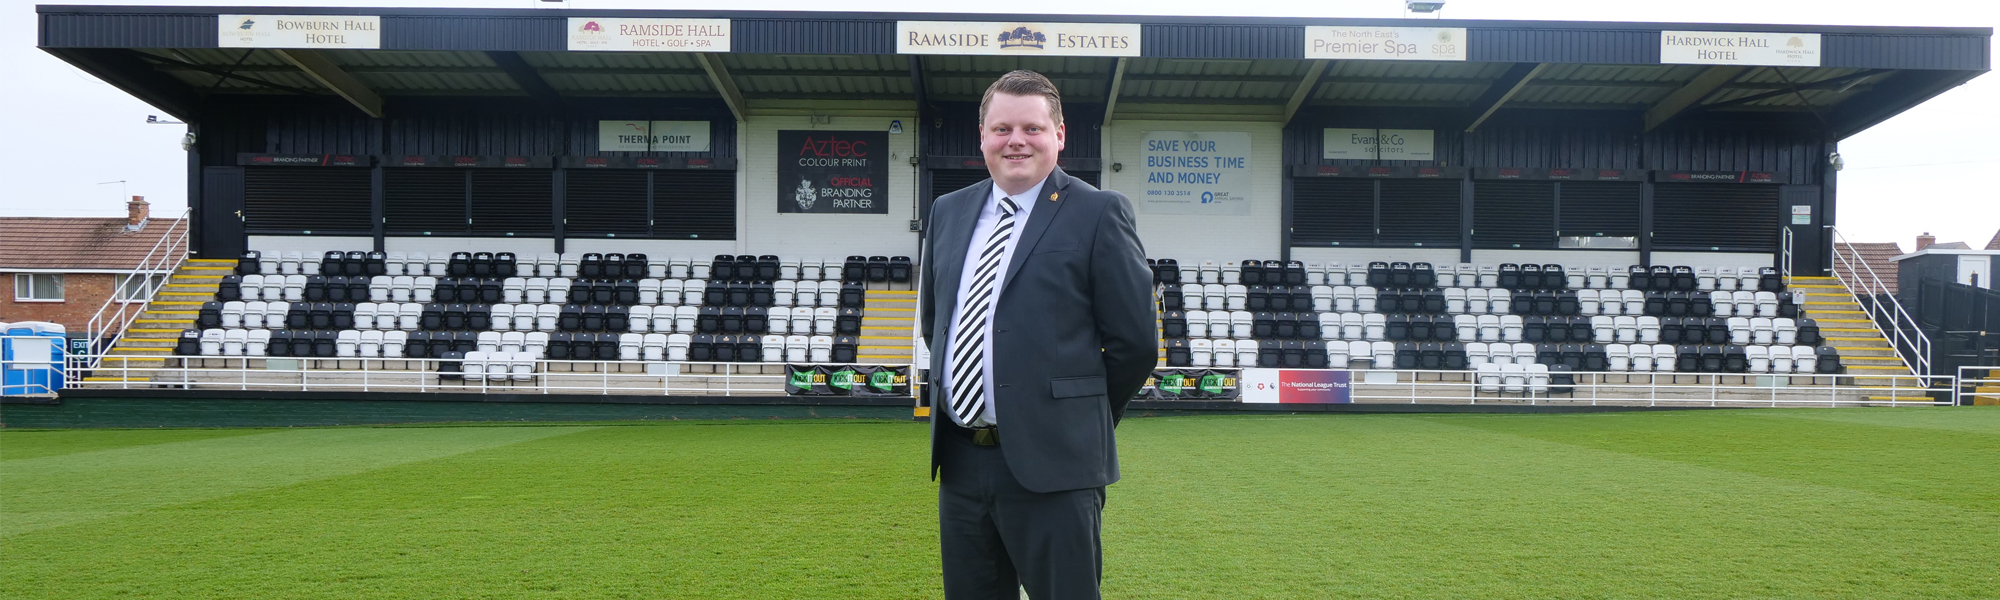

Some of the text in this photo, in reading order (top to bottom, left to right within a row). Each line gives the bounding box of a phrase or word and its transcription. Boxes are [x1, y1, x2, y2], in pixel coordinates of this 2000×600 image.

[277, 20, 376, 31] BOWBURN HALL
[620, 24, 725, 36] RAMSIDE HALL
[1349, 30, 1373, 38] North
[1374, 30, 1400, 38] East's
[306, 34, 347, 44] HOTEL
[632, 39, 712, 48] HOTEL GOLF SPA
[908, 31, 1129, 49] RAMSIDE ESTATES
[1666, 36, 1770, 48] HARDWICK HALL
[1314, 39, 1418, 57] Premier Spa
[1432, 44, 1456, 57] spa
[1697, 50, 1738, 60] HOTEL
[662, 136, 691, 144] POINT
[800, 135, 867, 157] Aztec
[1148, 140, 1216, 152] SAVE YOUR
[1364, 145, 1404, 154] solcitors
[798, 158, 867, 167] COLOUR PRINT
[1148, 156, 1245, 169] BUSINESS TIME
[831, 178, 872, 187] OFFICIAL
[1148, 172, 1221, 185] AND MONEY
[821, 188, 872, 198] BRANDING
[833, 200, 872, 208] PARTNER
[78, 350, 86, 359] C
[794, 374, 808, 383] KICK
[814, 374, 826, 383] OUT
[834, 375, 848, 383] KICK
[854, 374, 866, 383] OUT
[875, 375, 888, 384] KICK
[894, 375, 907, 384] OUT
[1164, 378, 1177, 387] KICK
[1183, 378, 1196, 387] OUT
[1204, 378, 1218, 387] KICK
[1224, 378, 1236, 387] OUT
